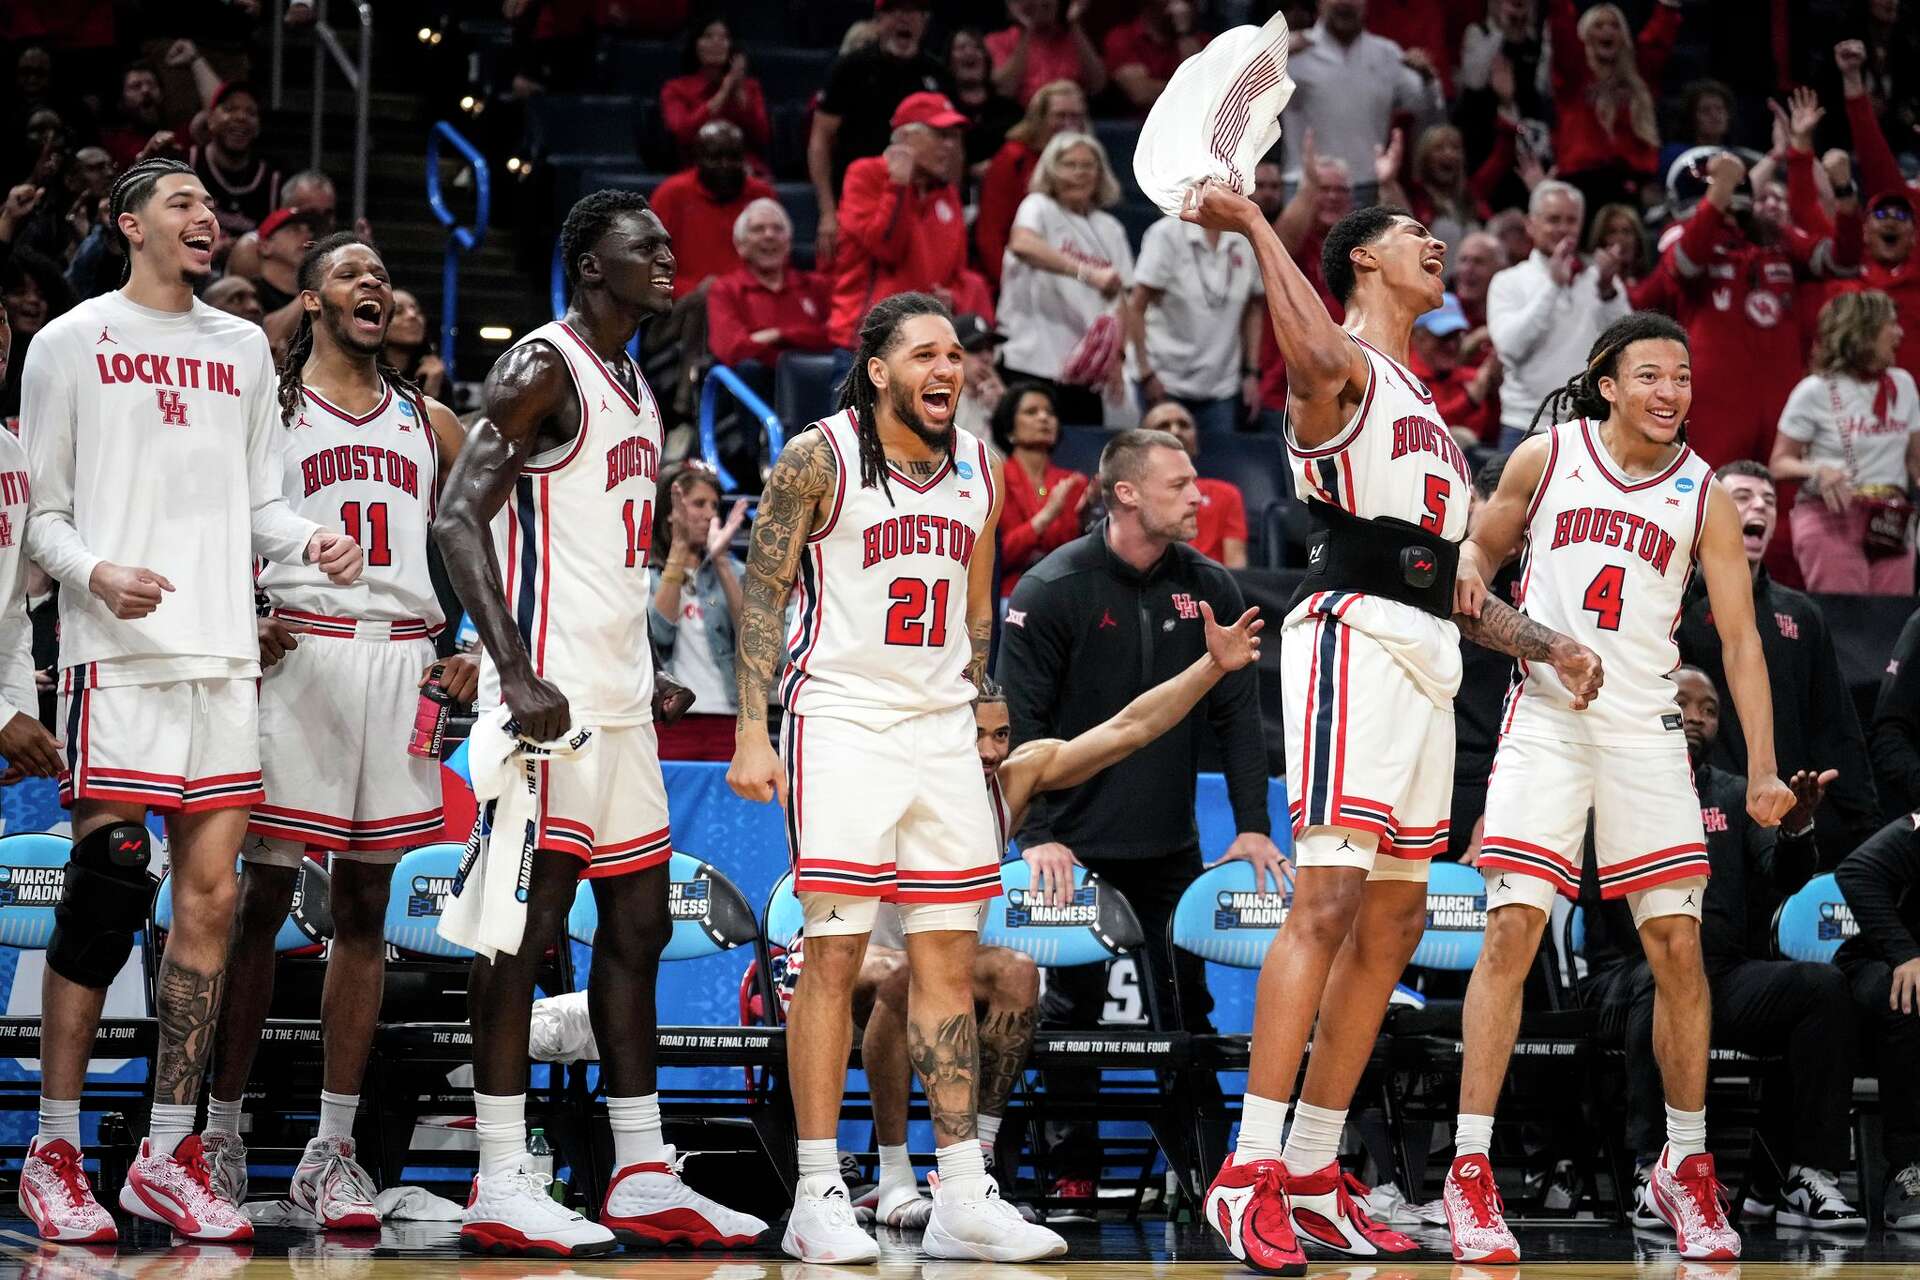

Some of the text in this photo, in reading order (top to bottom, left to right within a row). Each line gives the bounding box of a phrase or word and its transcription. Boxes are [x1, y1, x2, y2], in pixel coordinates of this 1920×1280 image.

[96, 353, 241, 398] LOCK IT IN.
[155, 389, 190, 427] UH
[1391, 415, 1472, 493] HOUSTON
[300, 444, 418, 500] HOUSTON
[1419, 473, 1451, 538] 5
[340, 501, 392, 567] 11
[622, 499, 654, 568] 14
[863, 514, 977, 570] HOUSTON
[1551, 507, 1677, 578] HOUSTON
[1172, 593, 1199, 620] UH
[1582, 564, 1626, 632] 4
[884, 577, 950, 648] 21
[11, 868, 65, 885] MARCH
[18, 885, 64, 901] MADN
[1233, 893, 1283, 909] MARCH
[670, 900, 708, 915] NESS
[1426, 895, 1474, 911] MARCH
[1031, 905, 1097, 922] MADNESS
[110, 1027, 136, 1039] FOUR
[261, 1028, 320, 1041] TO THE FINAL
[433, 1032, 473, 1044] THE ROA
[660, 1035, 769, 1048] ROAD TO THE FINAL FOUR
[1048, 1041, 1171, 1053] THE ROAD TO THE FINAL FOUR
[1526, 1043, 1551, 1055] FINAL
[1552, 1044, 1576, 1055] FOUR
[1718, 1049, 1735, 1060] THE
